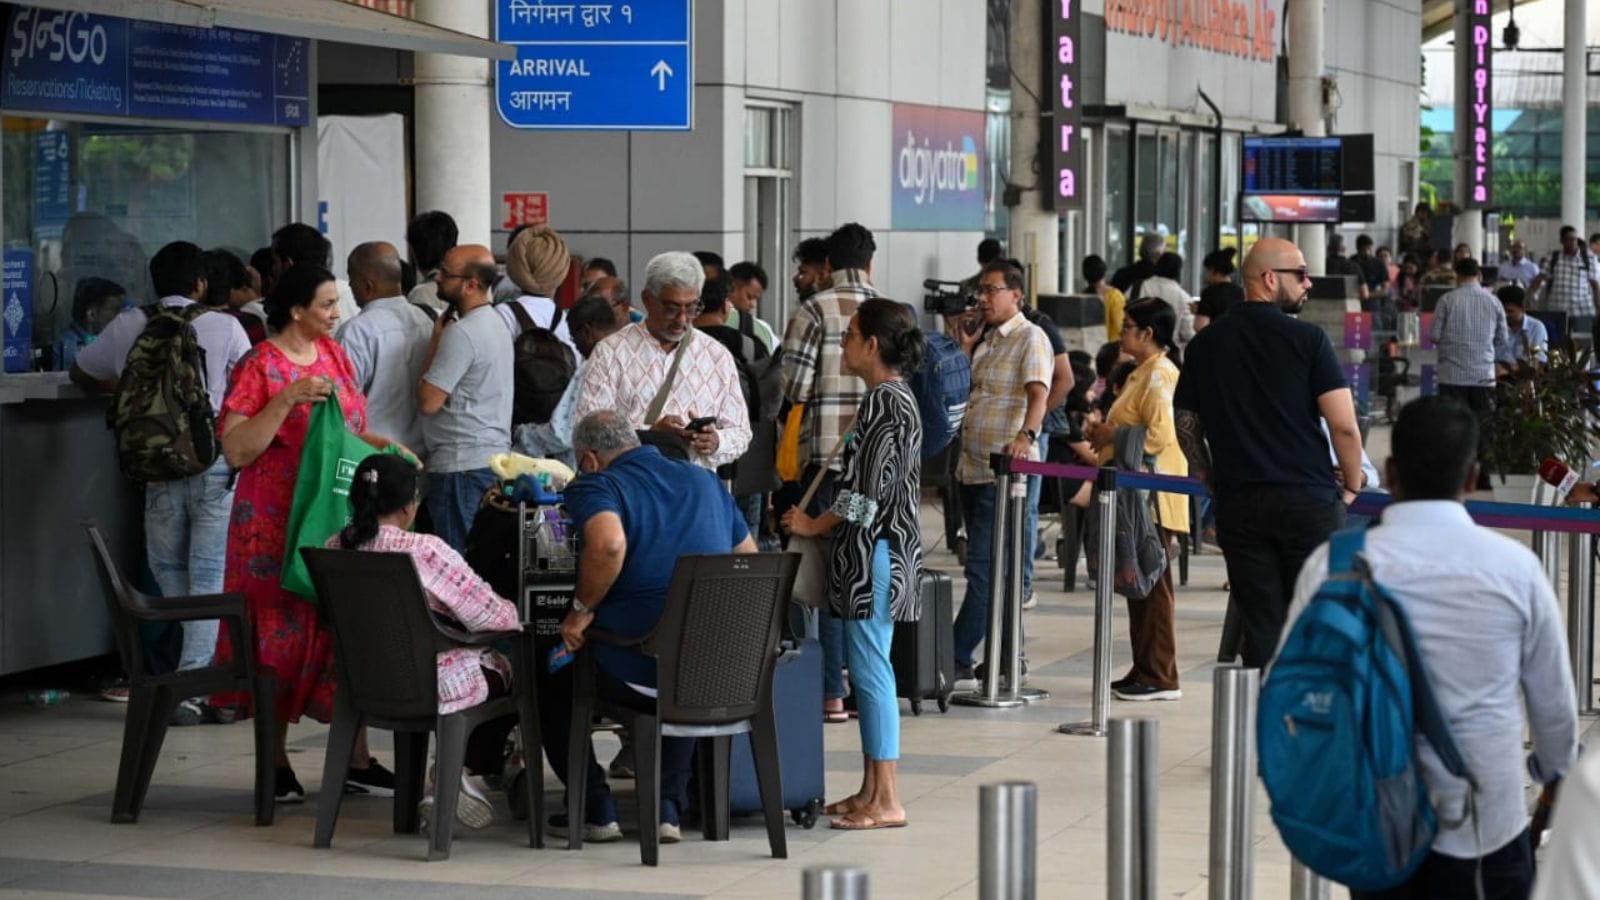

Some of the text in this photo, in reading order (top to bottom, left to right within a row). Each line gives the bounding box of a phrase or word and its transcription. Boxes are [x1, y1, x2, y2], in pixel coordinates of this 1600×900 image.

[509, 0, 575, 24] निर्गमन
[580, 5, 612, 28] द्वार
[509, 59, 591, 77] ARRIVAL
[509, 91, 572, 111] आगमन
[900, 129, 968, 204] digiyatra
